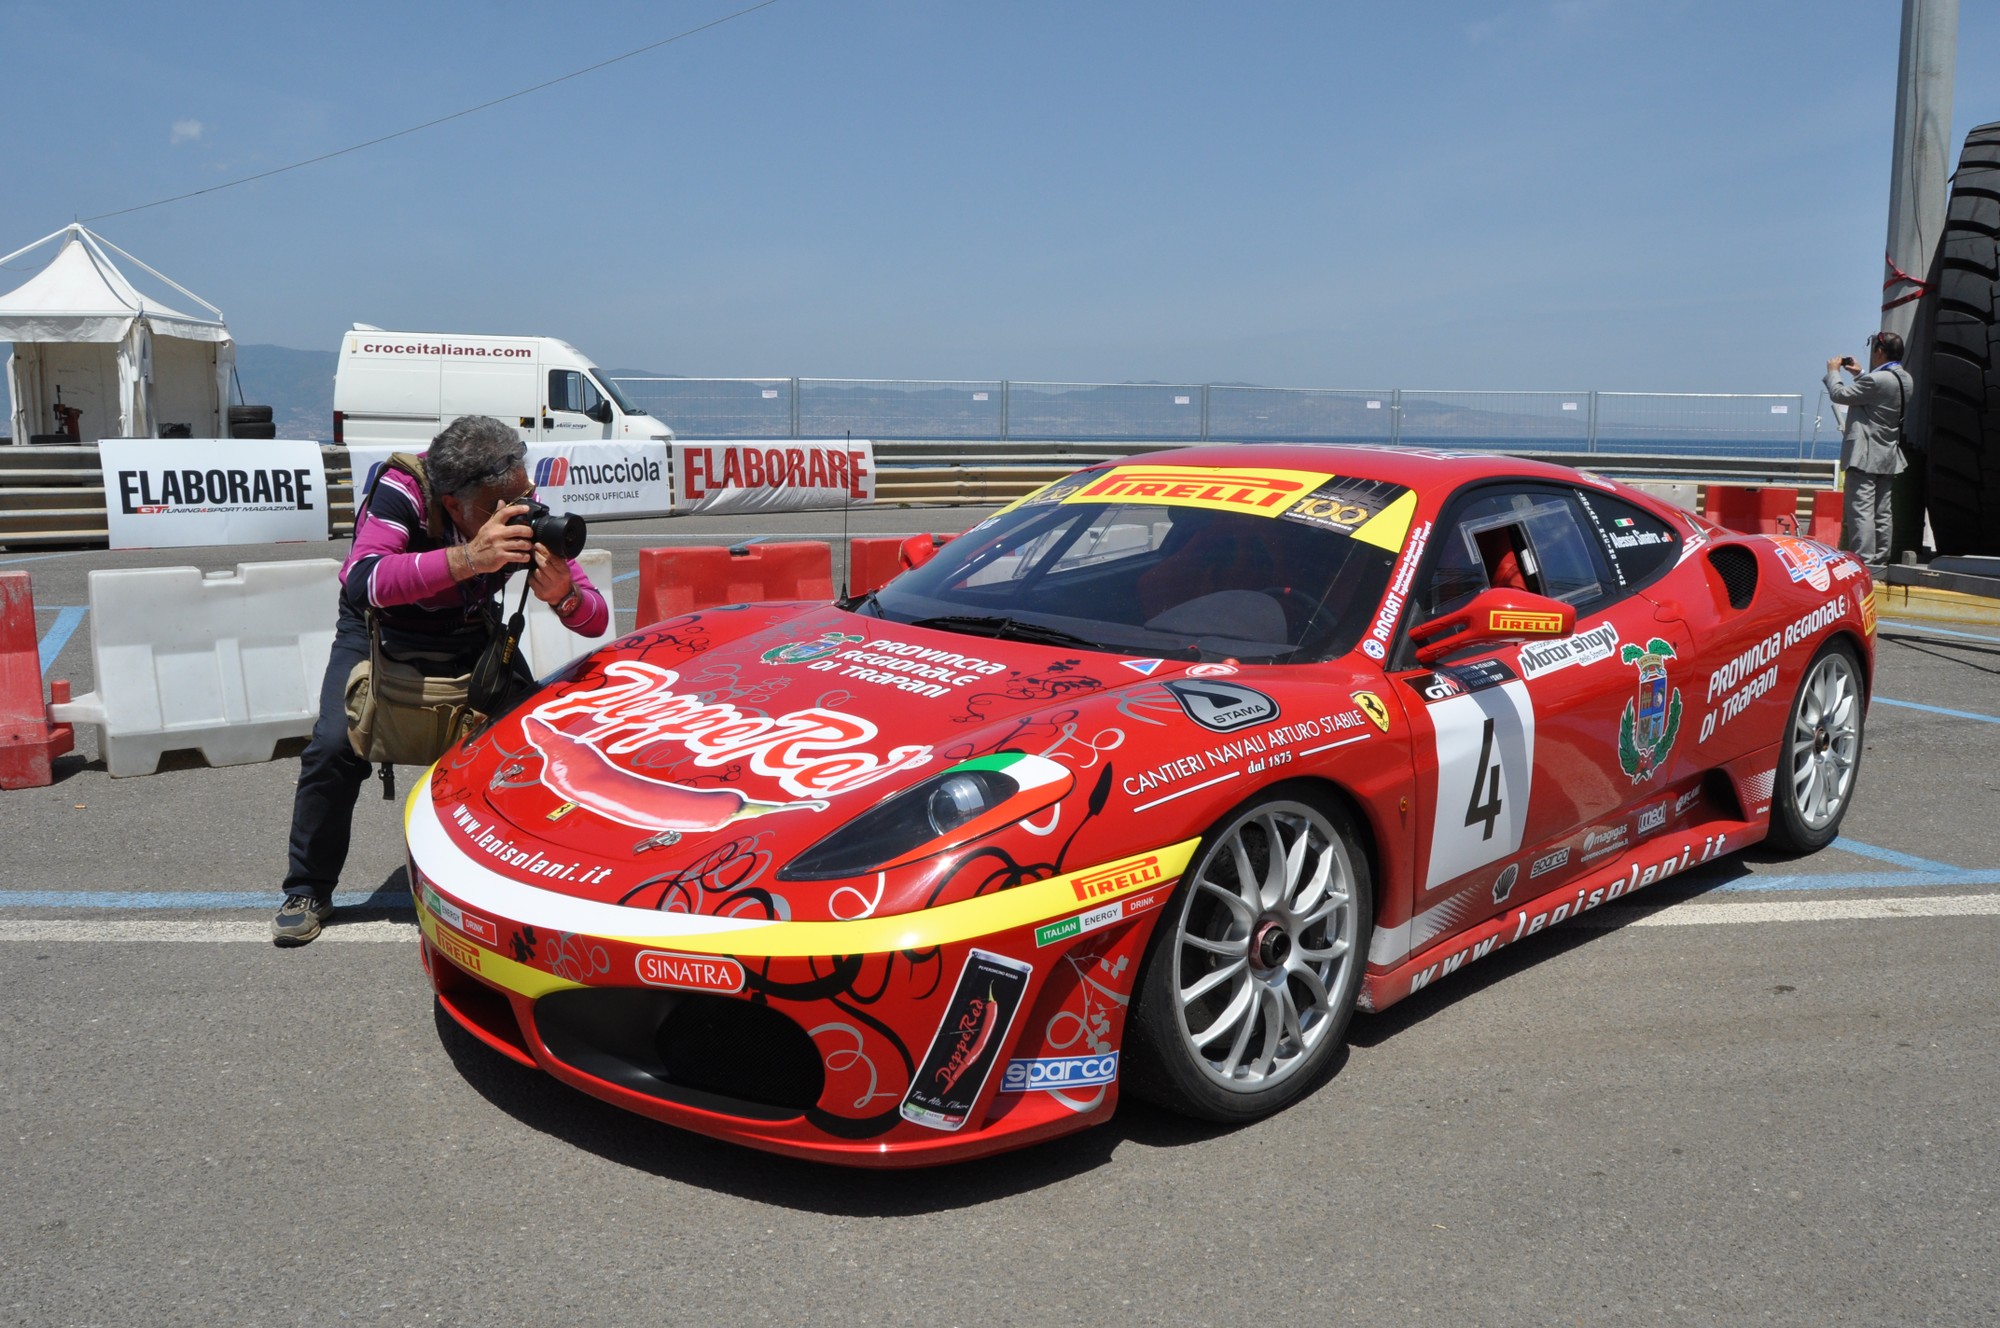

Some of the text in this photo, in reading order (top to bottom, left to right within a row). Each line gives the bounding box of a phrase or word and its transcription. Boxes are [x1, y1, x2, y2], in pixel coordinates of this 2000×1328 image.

[363, 342, 532, 358] croceitaliana.com
[569, 456, 660, 485] mucciola
[684, 447, 868, 499] ELABORARE
[118, 469, 313, 514] ELABORARE
[562, 490, 640, 503] SPONSOR UFFICIALE
[1080, 474, 1304, 507] PIRELLI
[1293, 498, 1369, 524] 100
[1599, 528, 1617, 560] RACING
[1614, 563, 1627, 586] TEAM
[1373, 591, 1403, 642] ANGLAT
[1492, 613, 1561, 631] PIRELLI
[862, 639, 1007, 675] PROVINCIA
[1521, 643, 1572, 677] Motor
[1707, 594, 1846, 704] PROVINCIA REGIONALE
[807, 660, 951, 698] DI TRAPANI
[835, 649, 980, 686] REGIONALE
[1213, 704, 1266, 724] STAMA
[1699, 665, 1778, 744] DI TRAPANI
[1122, 709, 1365, 796] CANTIERI NAVALI ARTURO STABILE
[1248, 751, 1293, 775] dal 1875
[1464, 717, 1503, 841] 4
[452, 803, 613, 885] www.leoisolani.it
[1533, 848, 1569, 873] sparco
[1070, 856, 1162, 901] PIRELLI
[465, 919, 484, 934] DRINK
[1043, 896, 1154, 940] ITALIAN ENERGY DRINK
[1409, 833, 1727, 995] www.leoisolani.it
[435, 923, 481, 973] PIRELLI
[646, 958, 733, 986] SINATRA
[978, 965, 1006, 976] PEPERONCINO
[1005, 1056, 1116, 1088] sparco
